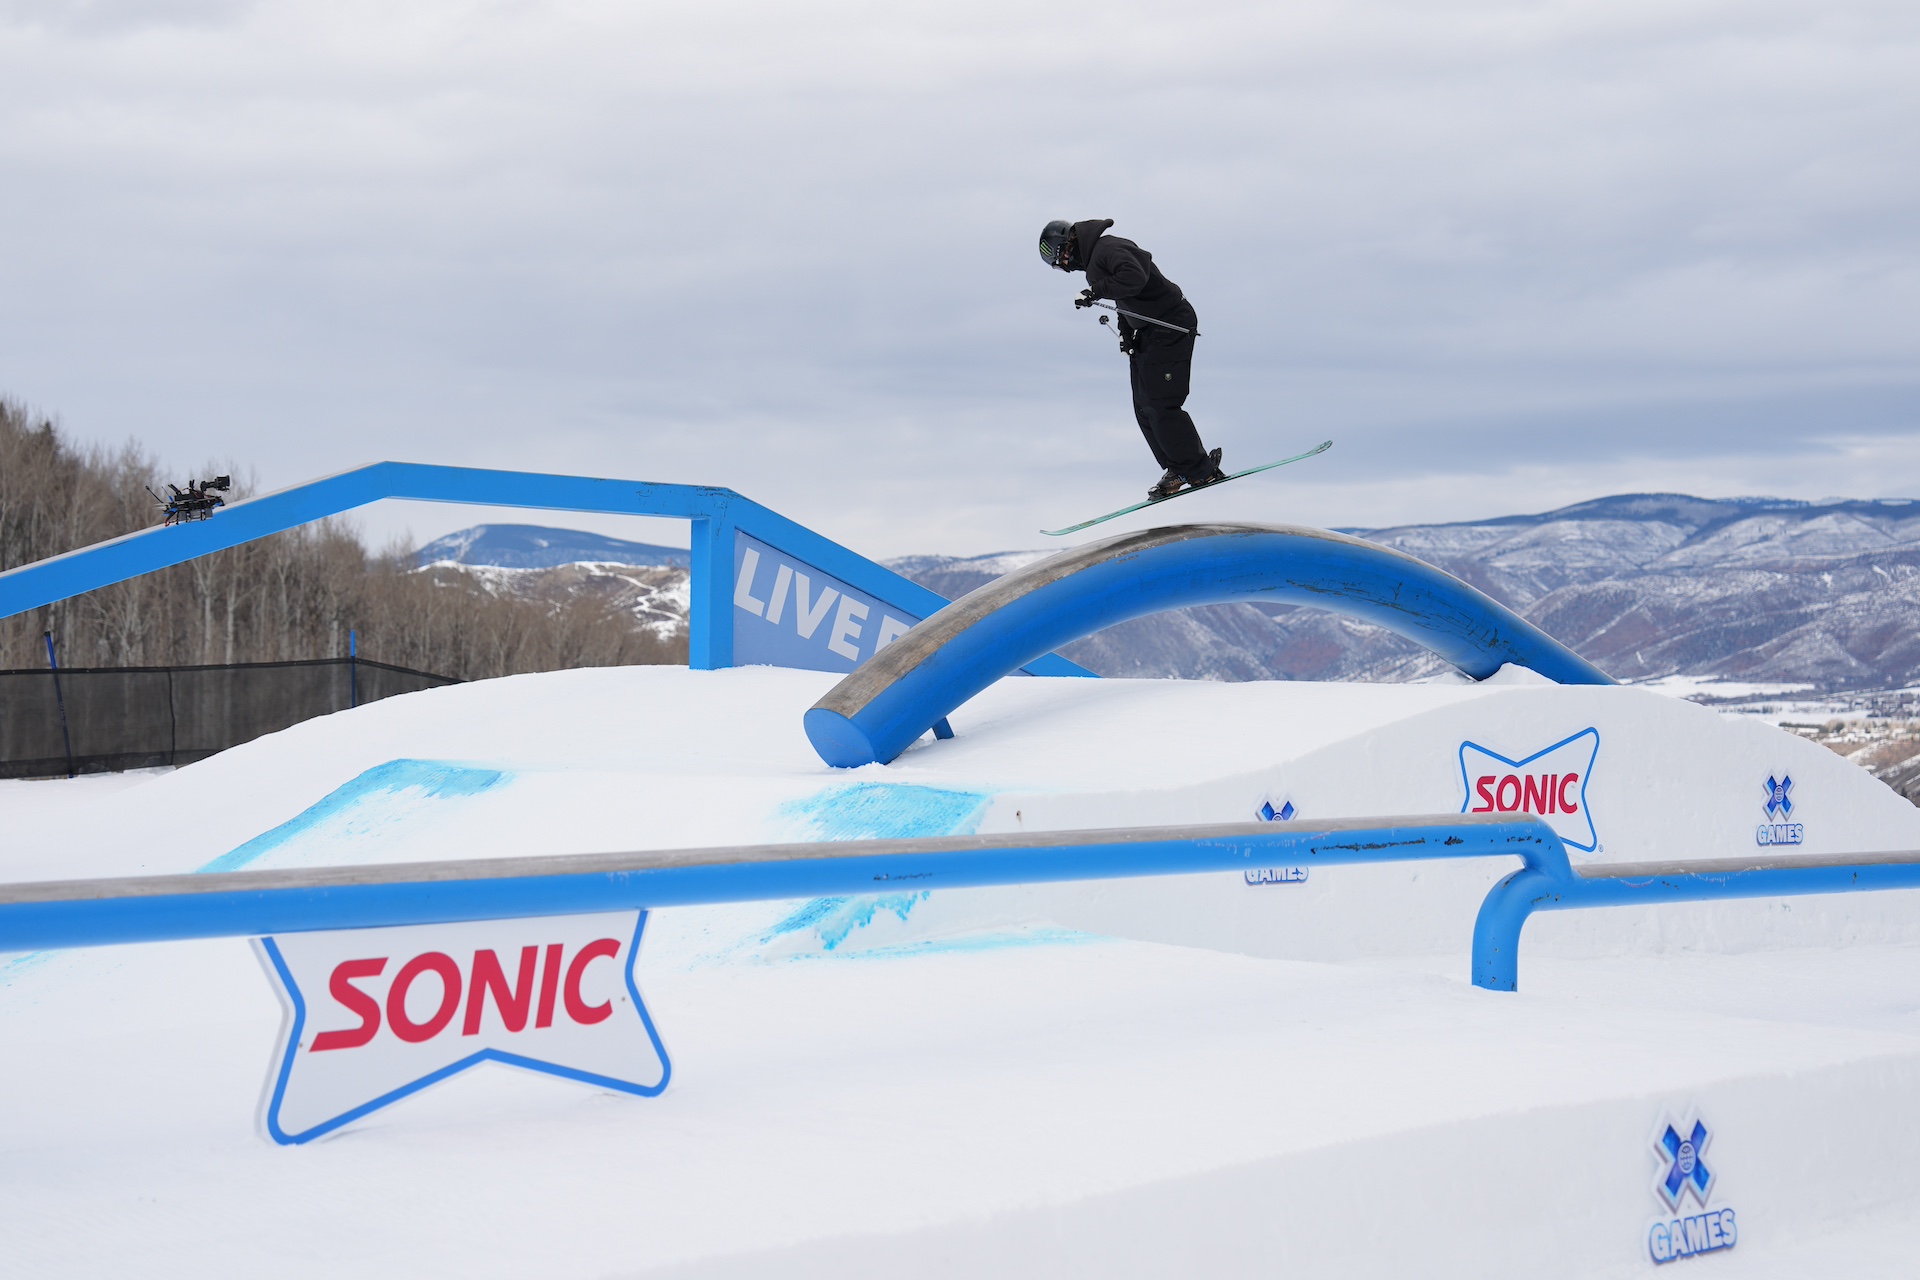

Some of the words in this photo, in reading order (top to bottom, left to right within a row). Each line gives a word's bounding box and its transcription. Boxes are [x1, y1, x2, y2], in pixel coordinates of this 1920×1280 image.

[733, 547, 870, 662] LIVE
[1472, 773, 1579, 815] SONIC
[1765, 773, 1793, 818] X
[1756, 823, 1803, 846] GAMES
[308, 938, 622, 1053] SONIC
[1658, 1114, 1713, 1206] X
[1650, 1208, 1738, 1264] GAMES
